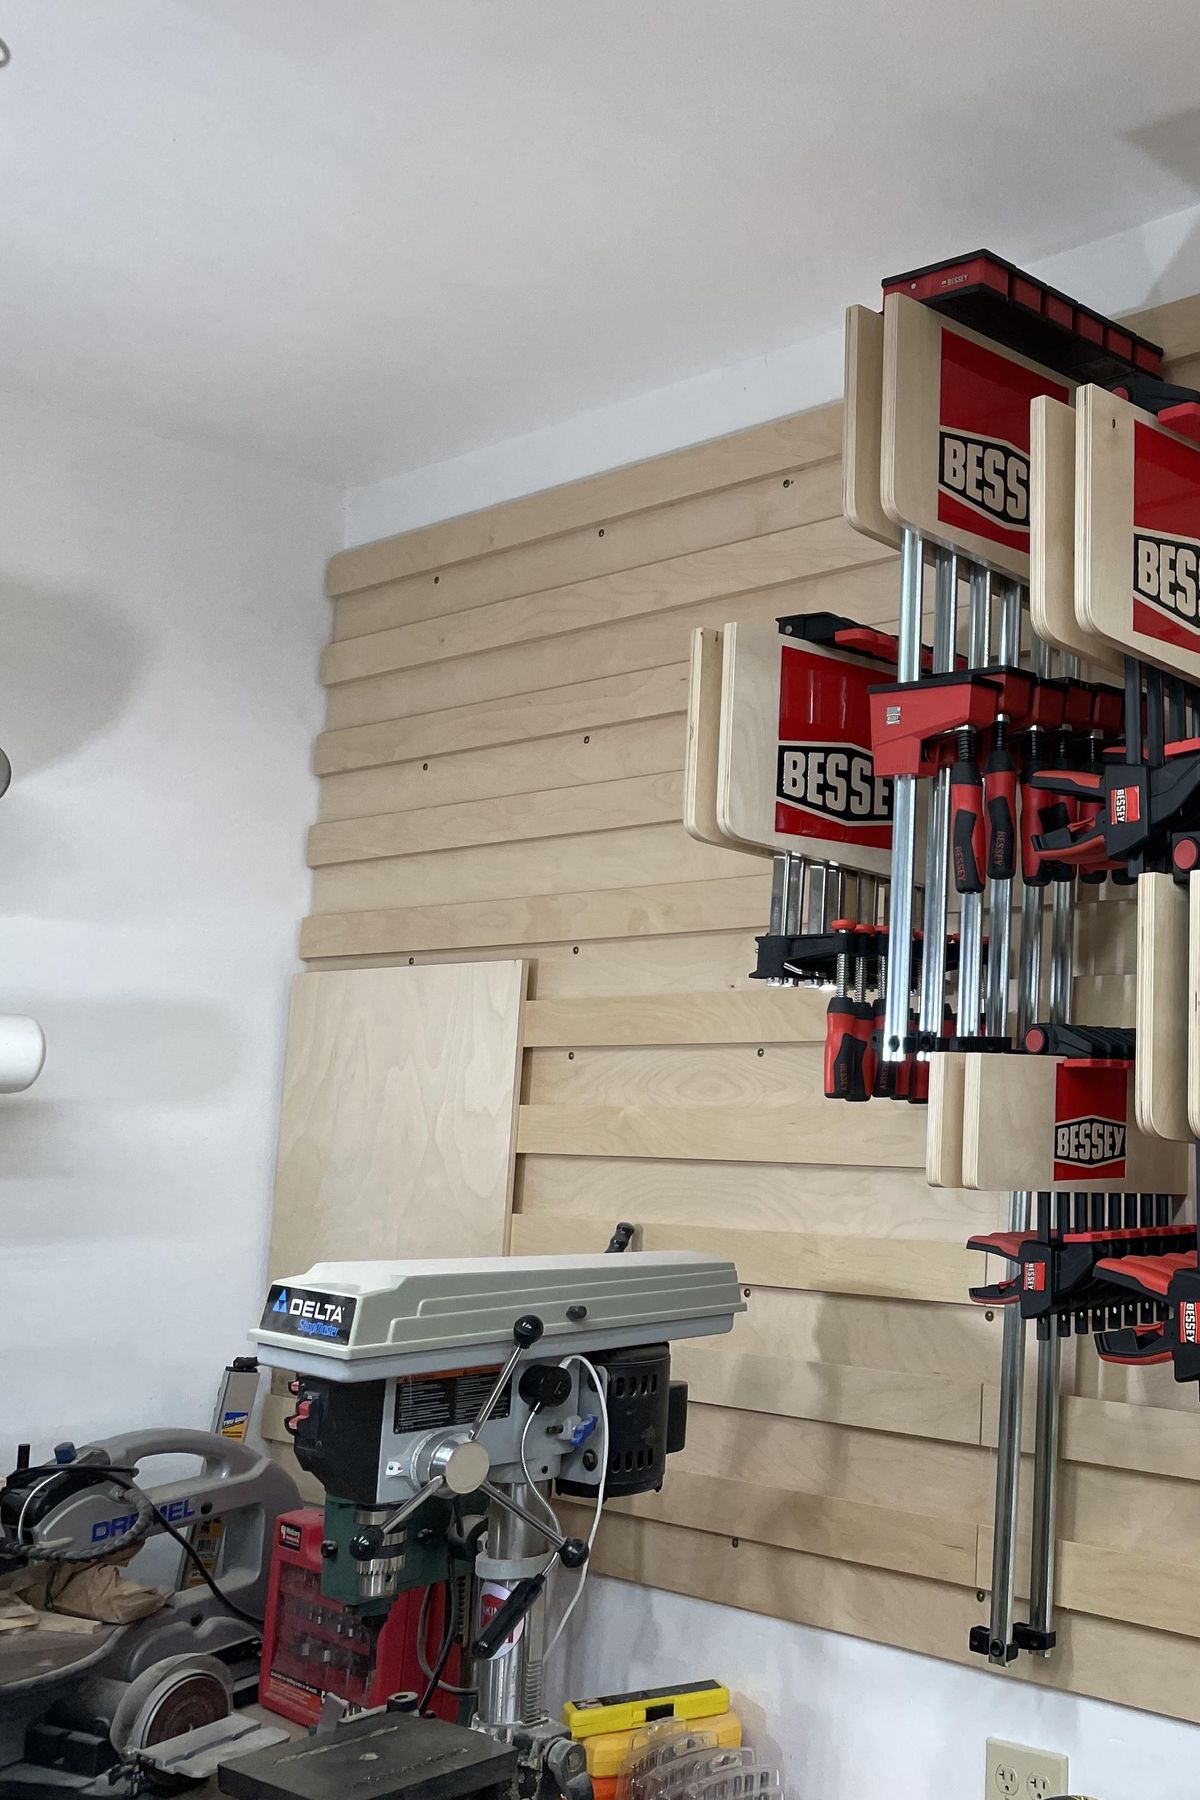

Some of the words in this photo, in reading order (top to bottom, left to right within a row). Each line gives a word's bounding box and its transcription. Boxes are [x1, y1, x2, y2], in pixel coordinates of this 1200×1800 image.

[943, 436, 1030, 520] BESS
[783, 751, 889, 815] BESSE
[1115, 788, 1125, 823] BESSEY
[1057, 1124, 1124, 1161] BESSEY
[1027, 1263, 1035, 1291] BESSEY
[288, 1298, 342, 1324] DELTA
[1184, 1302, 1195, 1344] BESSEY
